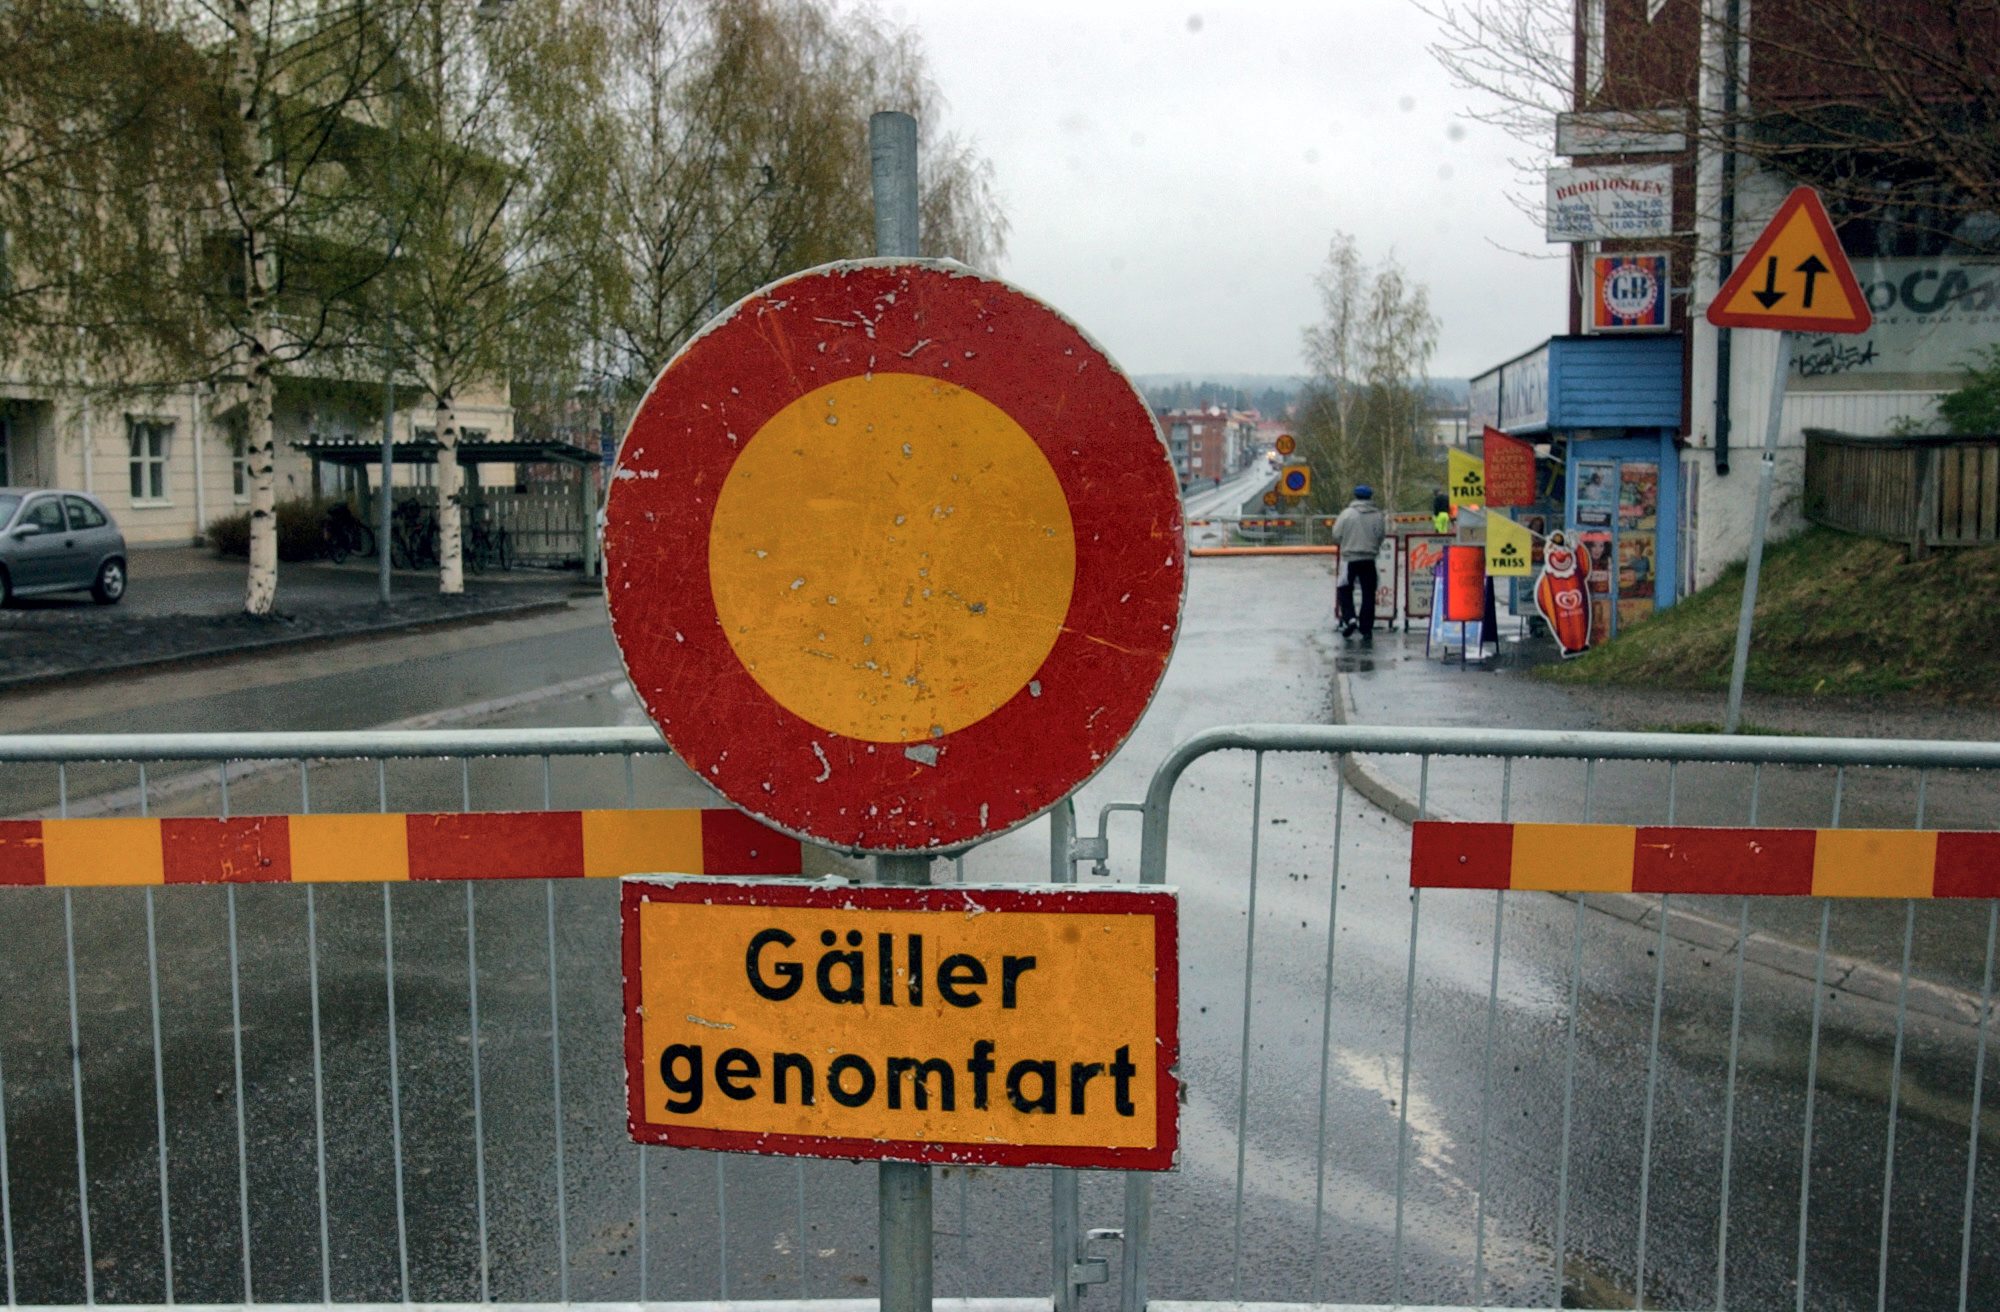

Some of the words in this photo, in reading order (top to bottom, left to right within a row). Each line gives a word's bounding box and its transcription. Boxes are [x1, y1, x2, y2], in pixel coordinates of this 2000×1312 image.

[1555, 177, 1663, 200] BROKIOSKEN
[1612, 274, 1648, 300] GB
[1452, 486, 1486, 497] TRIS
[1491, 557, 1525, 568] TRISS
[745, 926, 1037, 1010] Gäller
[659, 1039, 1137, 1117] genomfart
